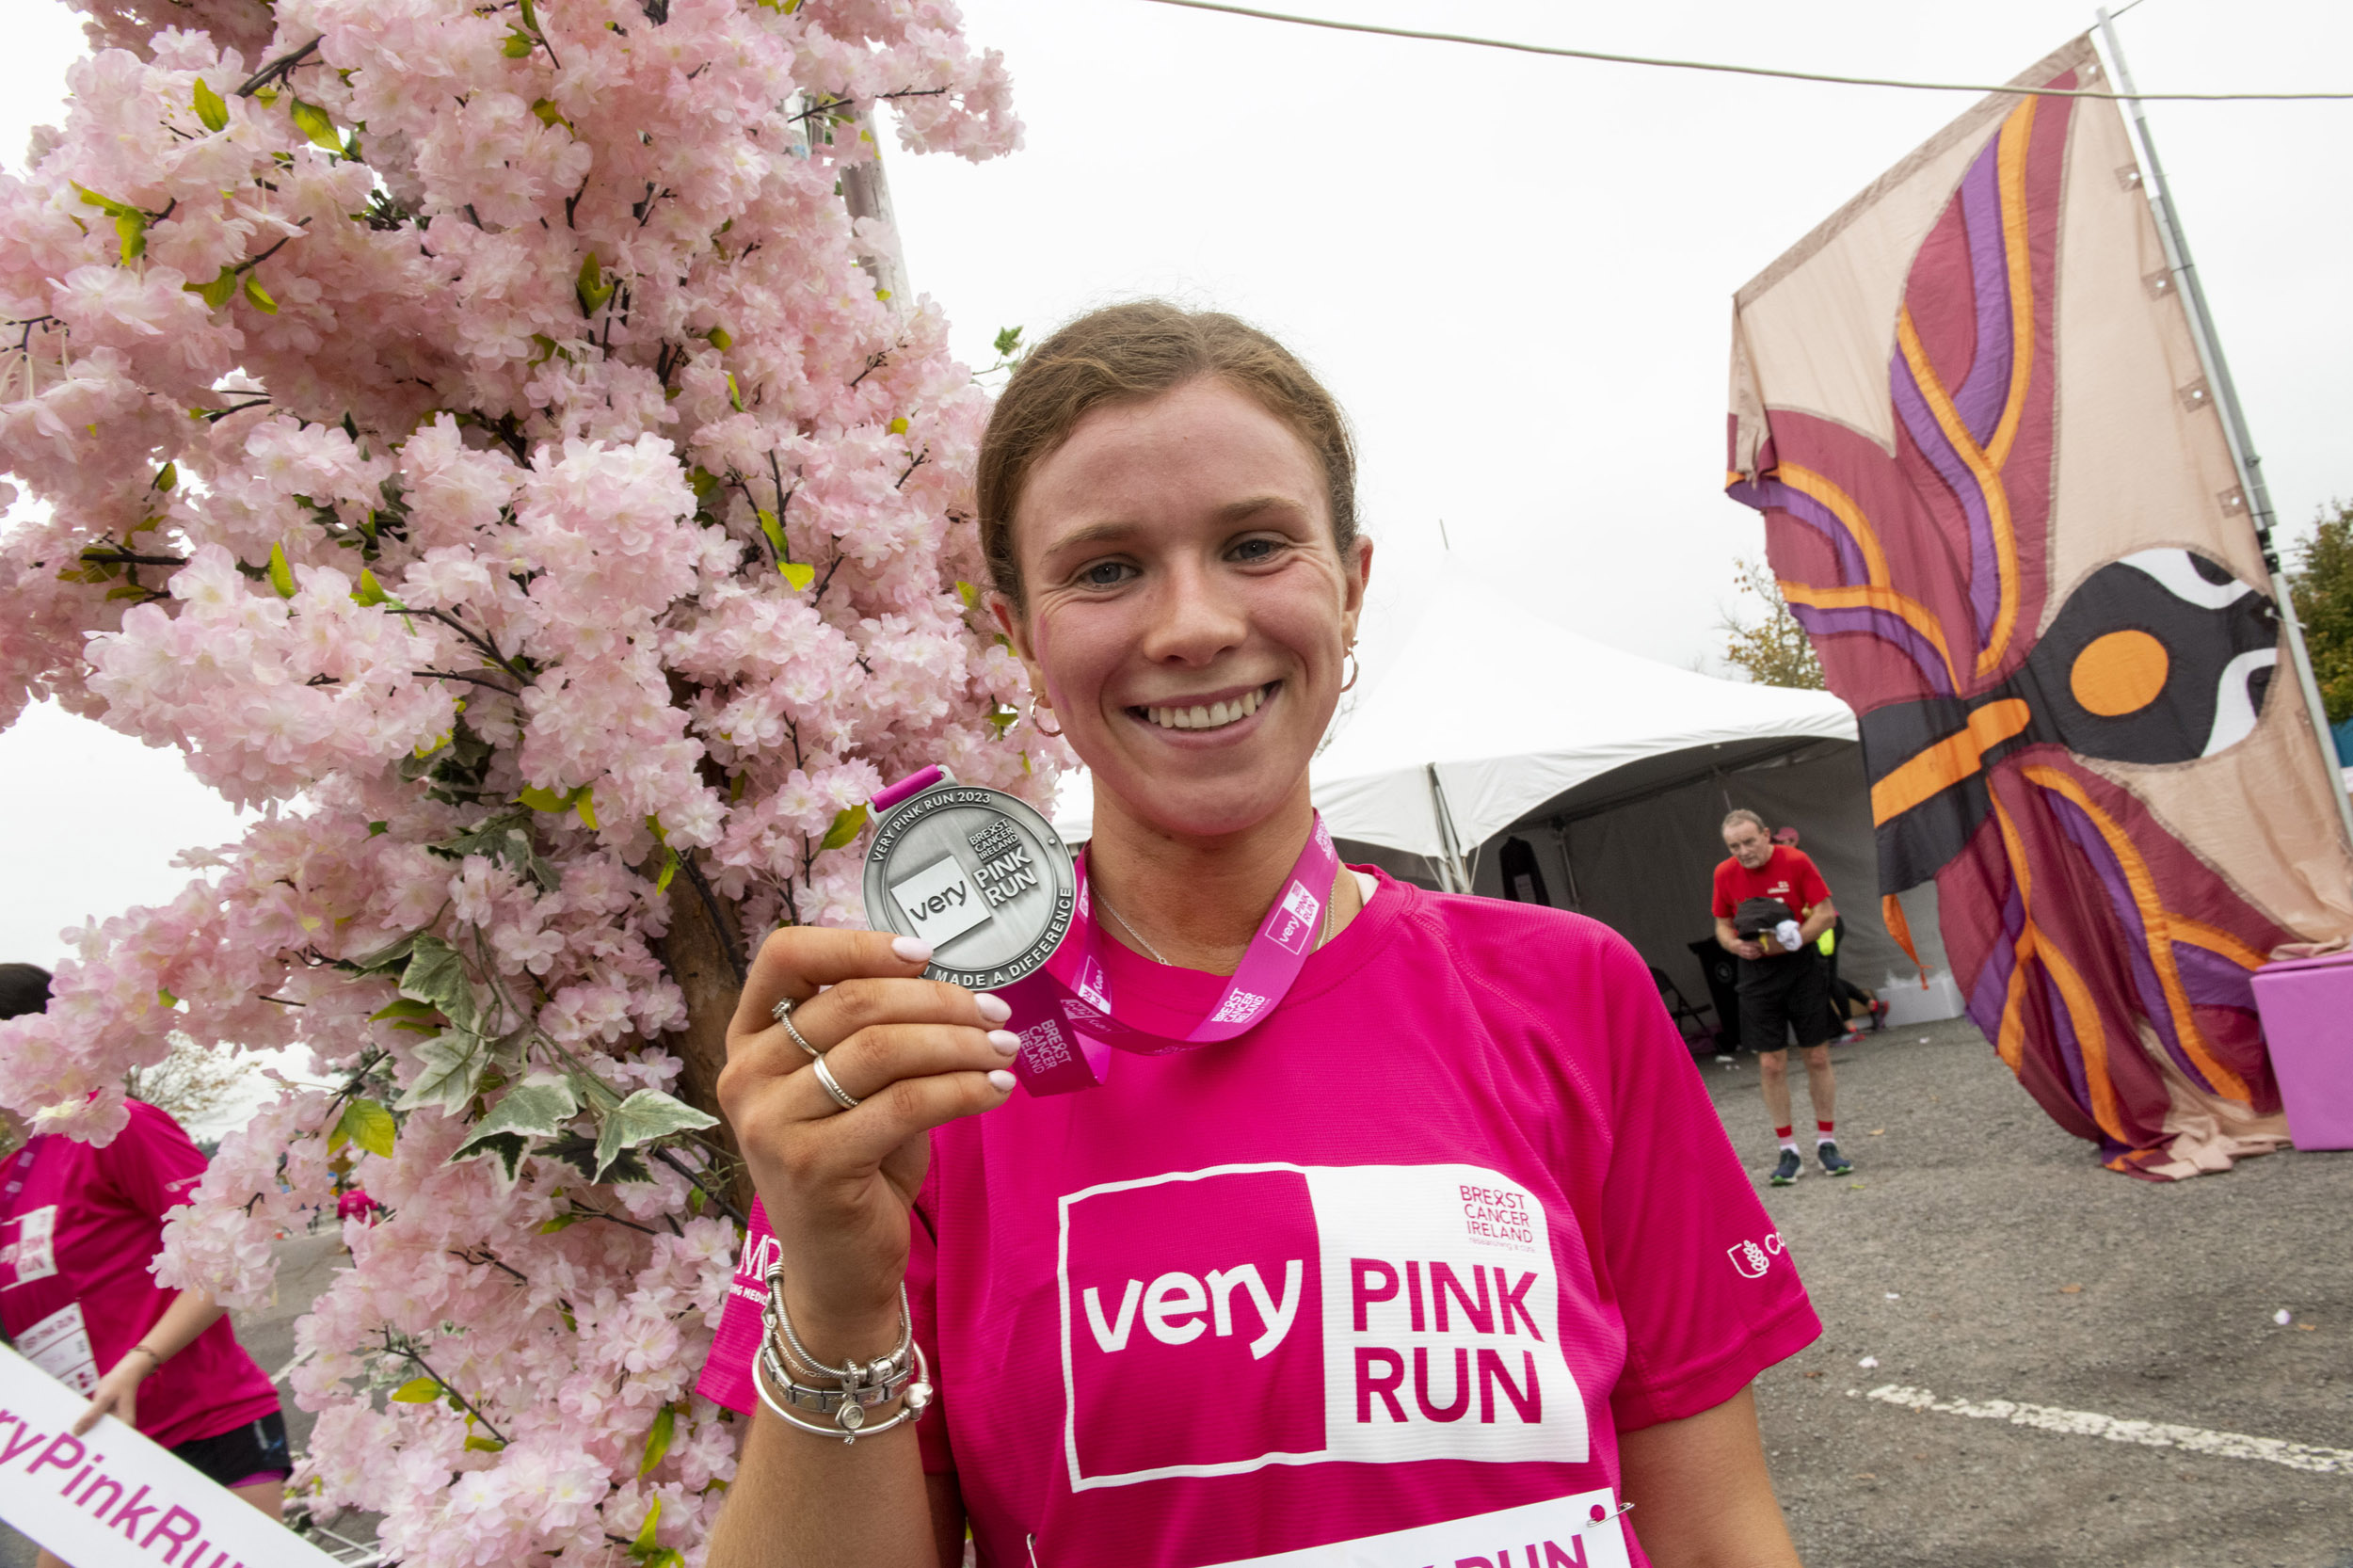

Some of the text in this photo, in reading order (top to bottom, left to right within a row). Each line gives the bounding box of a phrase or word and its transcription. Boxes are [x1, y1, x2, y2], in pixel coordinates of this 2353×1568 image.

[872, 792, 991, 862] VERY PINK RUN 2023
[974, 826, 1015, 853] CANCER
[978, 834, 1018, 860] IRELAND
[972, 846, 1032, 889] PINK
[984, 867, 1038, 907] RUN
[909, 880, 967, 922] very
[1294, 890, 1309, 917] PINK
[1302, 900, 1316, 922] RUN
[935, 969, 986, 986] MADE
[993, 972, 1004, 984] A
[1008, 888, 1072, 978] DIFFERENCE
[1279, 916, 1300, 943] very
[1016, 1030, 1045, 1074] IRELAND
[1029, 1025, 1058, 1070] CANCER
[1464, 1203, 1530, 1227] CANCER
[1466, 1220, 1534, 1243] IRELAND
[1082, 1257, 1546, 1360] very PINK
[1354, 1347, 1543, 1424] RUN
